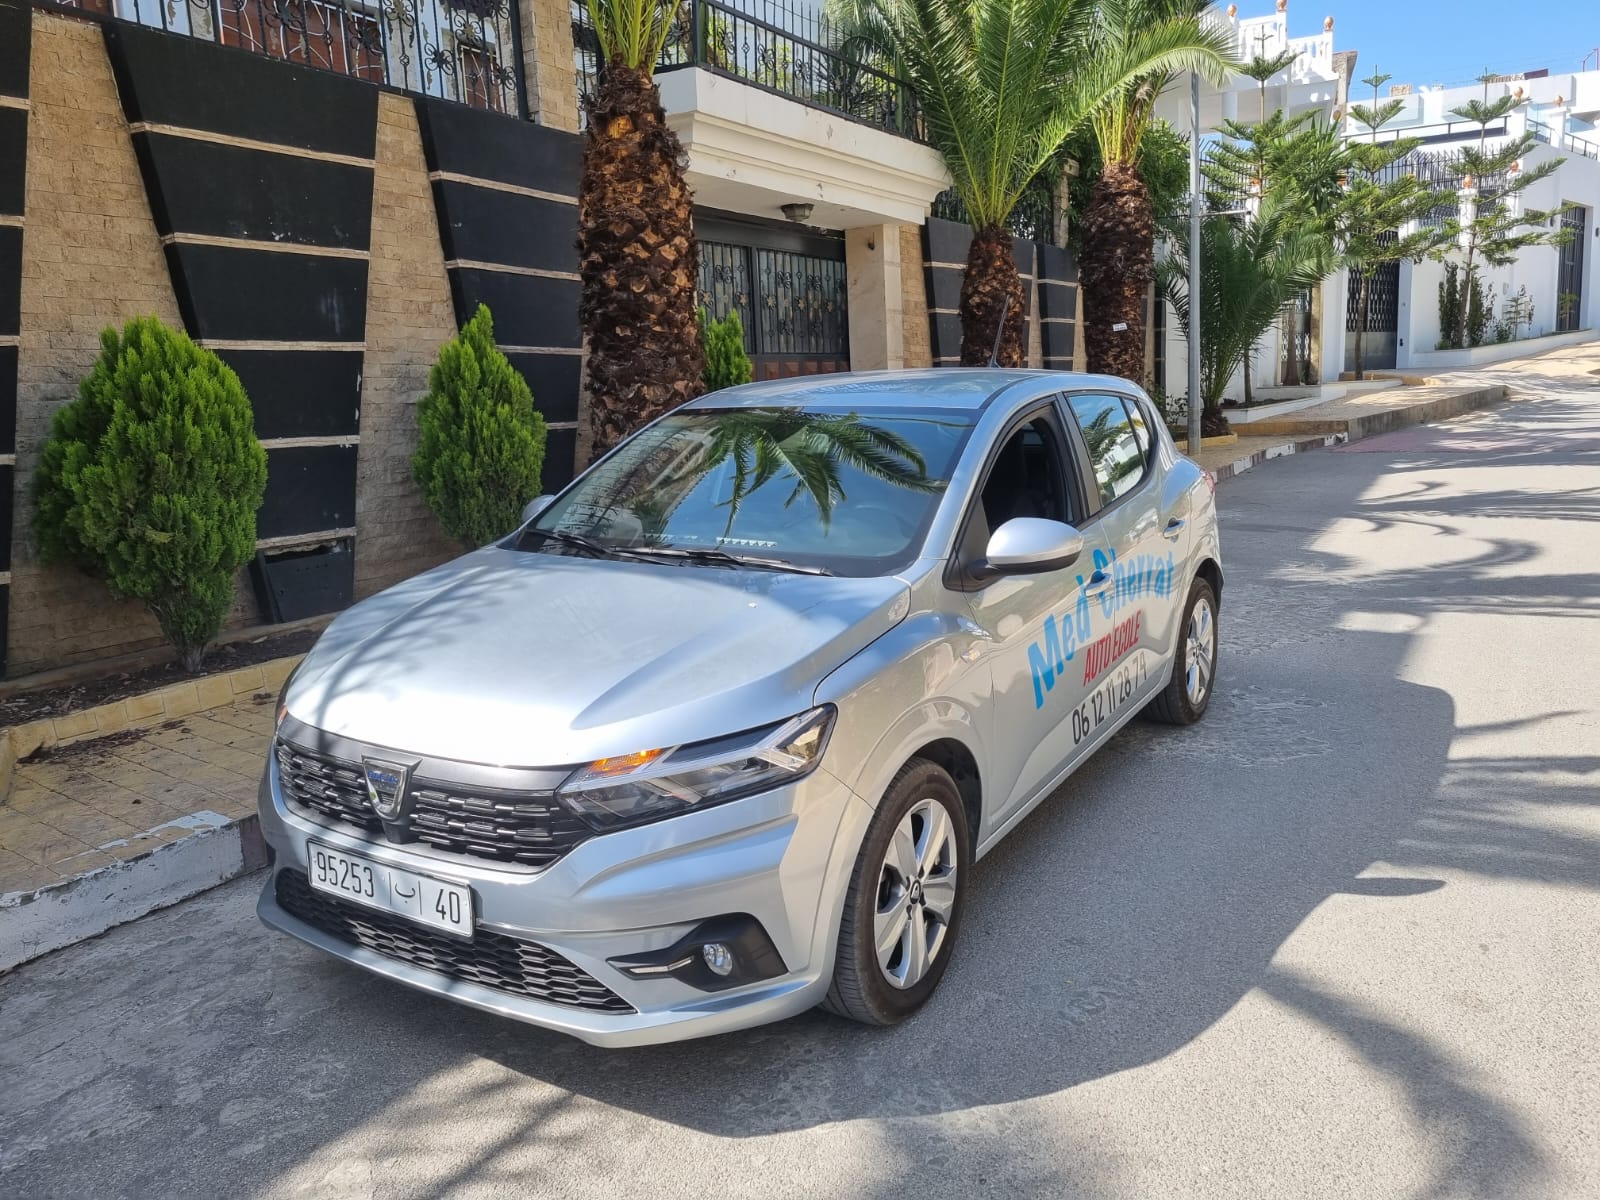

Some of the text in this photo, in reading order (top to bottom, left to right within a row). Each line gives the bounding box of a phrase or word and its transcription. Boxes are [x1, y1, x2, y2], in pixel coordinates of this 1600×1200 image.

[1028, 574, 1091, 710] Med
[1083, 608, 1142, 688] AUTO ECOLE
[1072, 703, 1090, 745] 06
[1091, 689, 1105, 727] 12
[1106, 678, 1116, 714] 11
[1117, 665, 1132, 705] 28
[316, 851, 374, 898] 95253
[434, 888, 461, 924] 40
